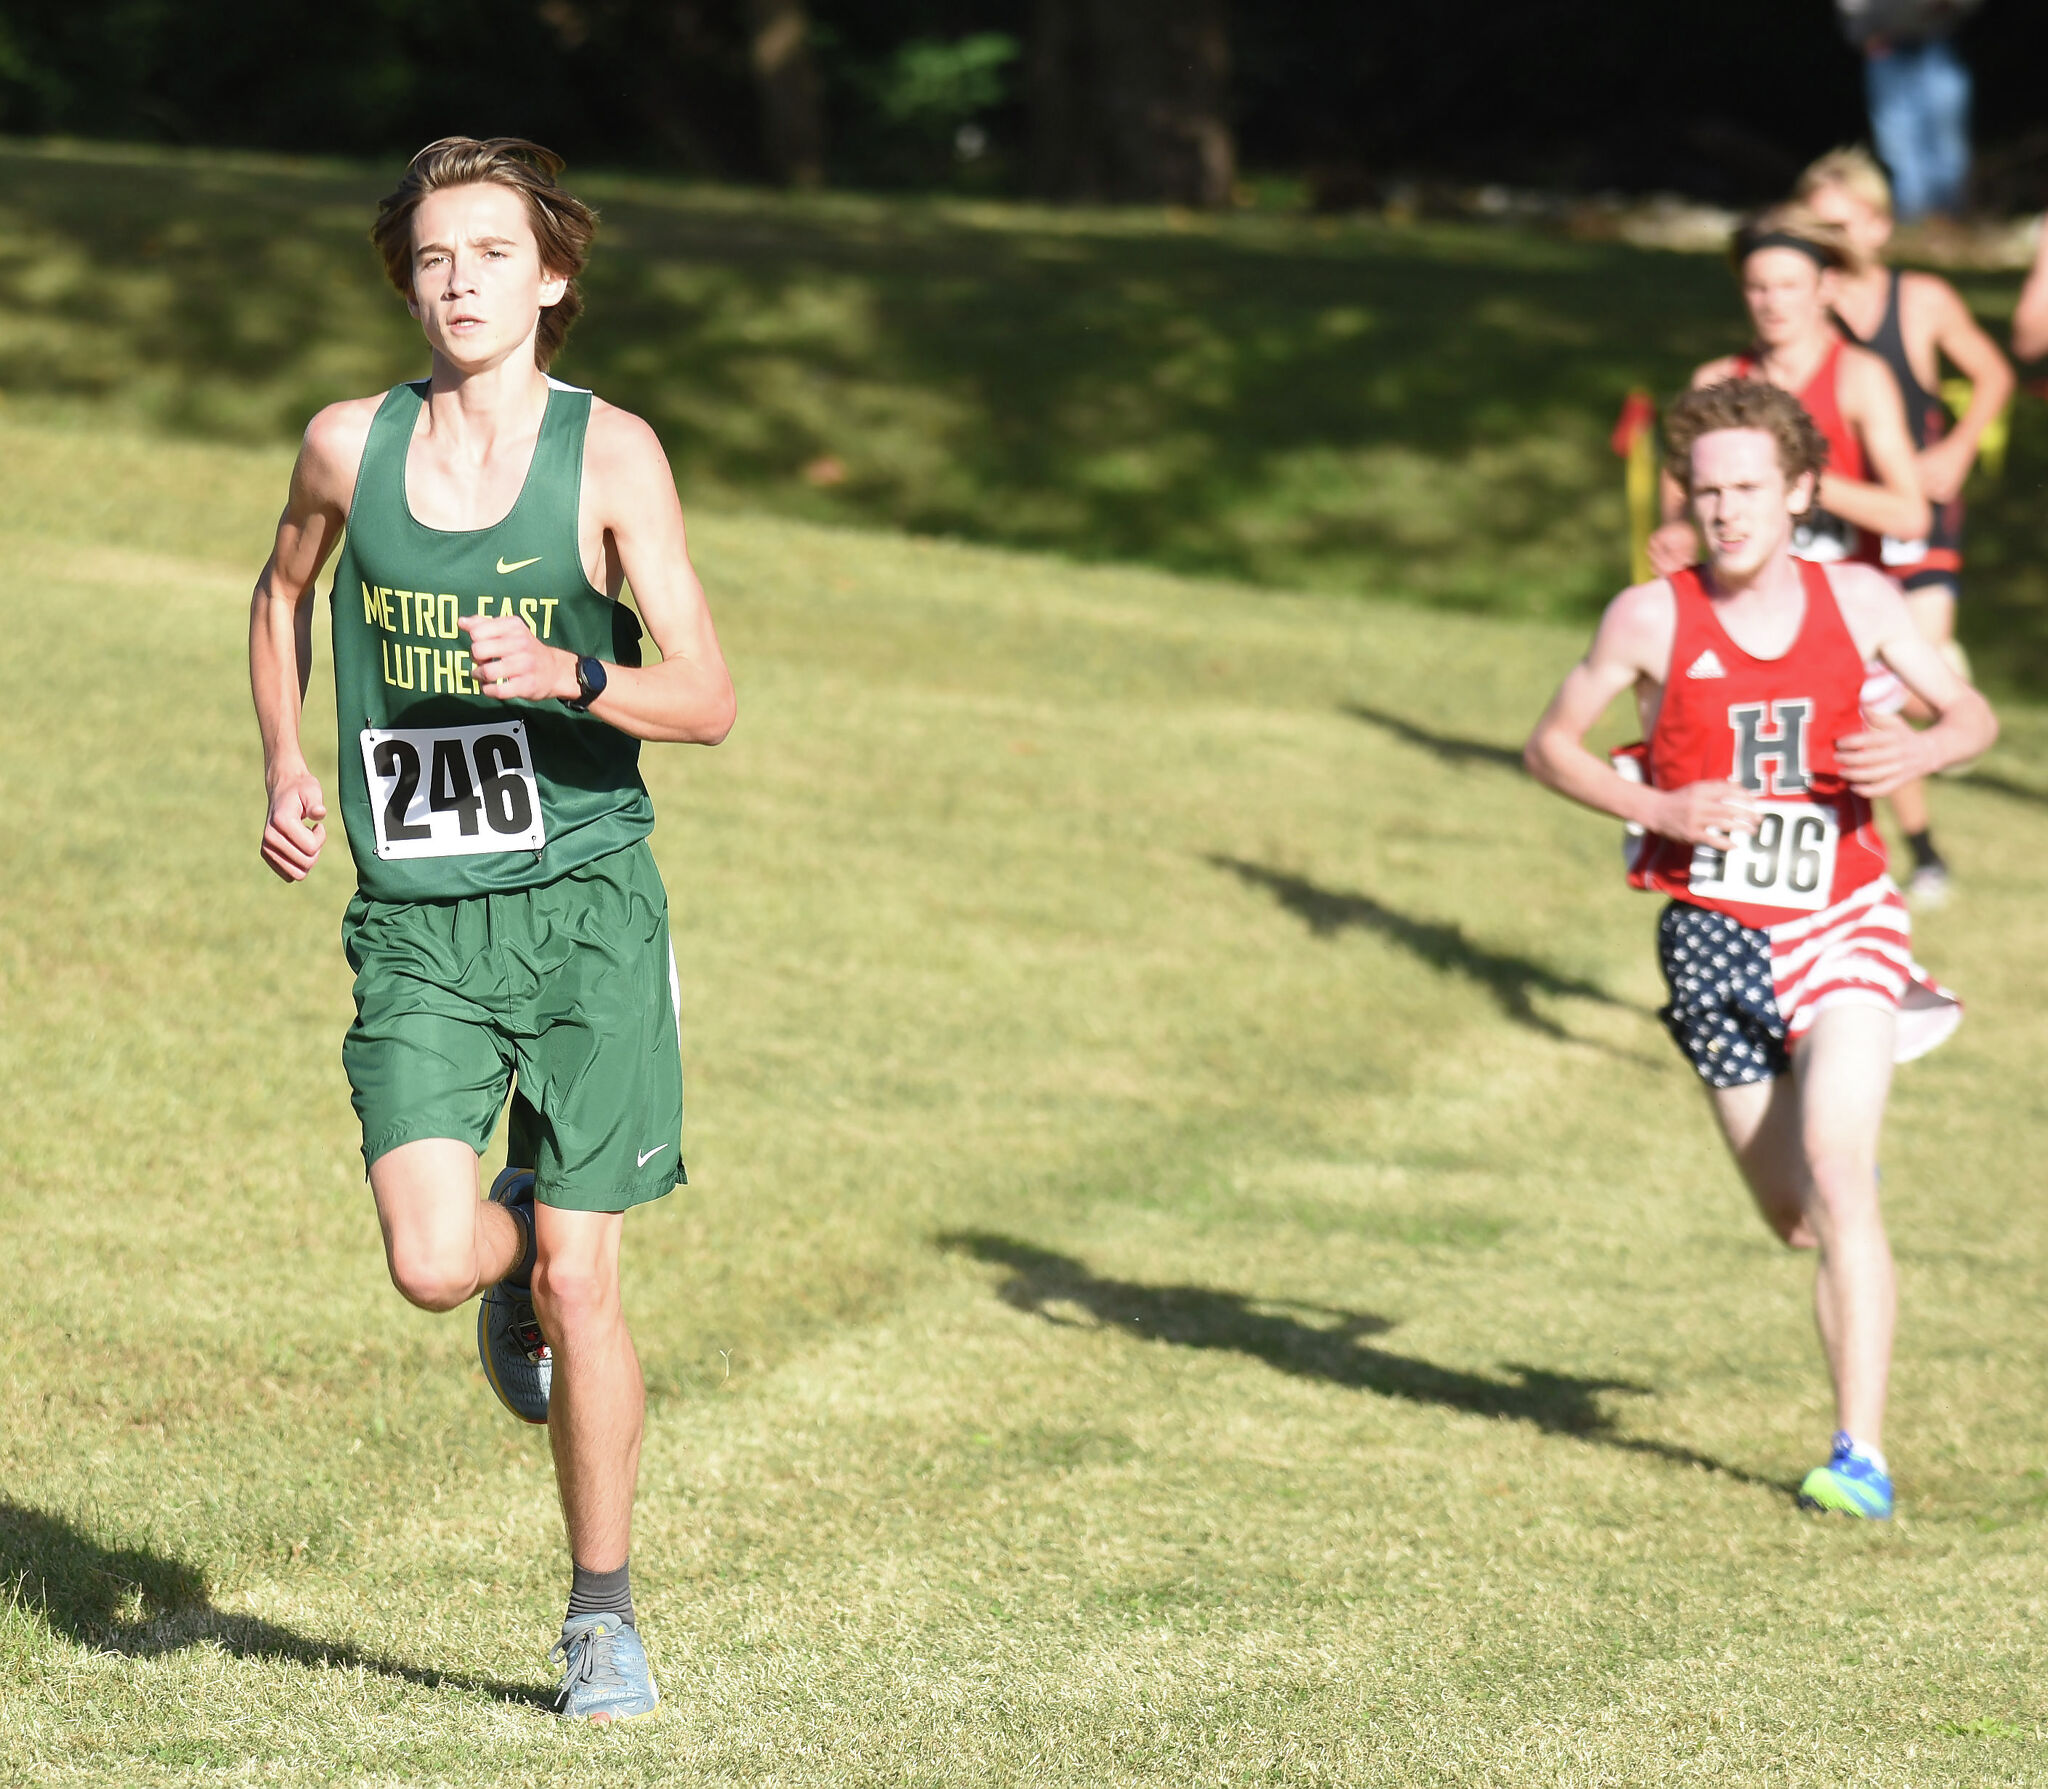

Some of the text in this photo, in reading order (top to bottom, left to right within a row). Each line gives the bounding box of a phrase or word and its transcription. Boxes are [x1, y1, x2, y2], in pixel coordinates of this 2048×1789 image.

[361, 580, 460, 640] METRO
[382, 639, 509, 696] LUTHE
[1728, 696, 1814, 797] H
[372, 733, 533, 842] 246
